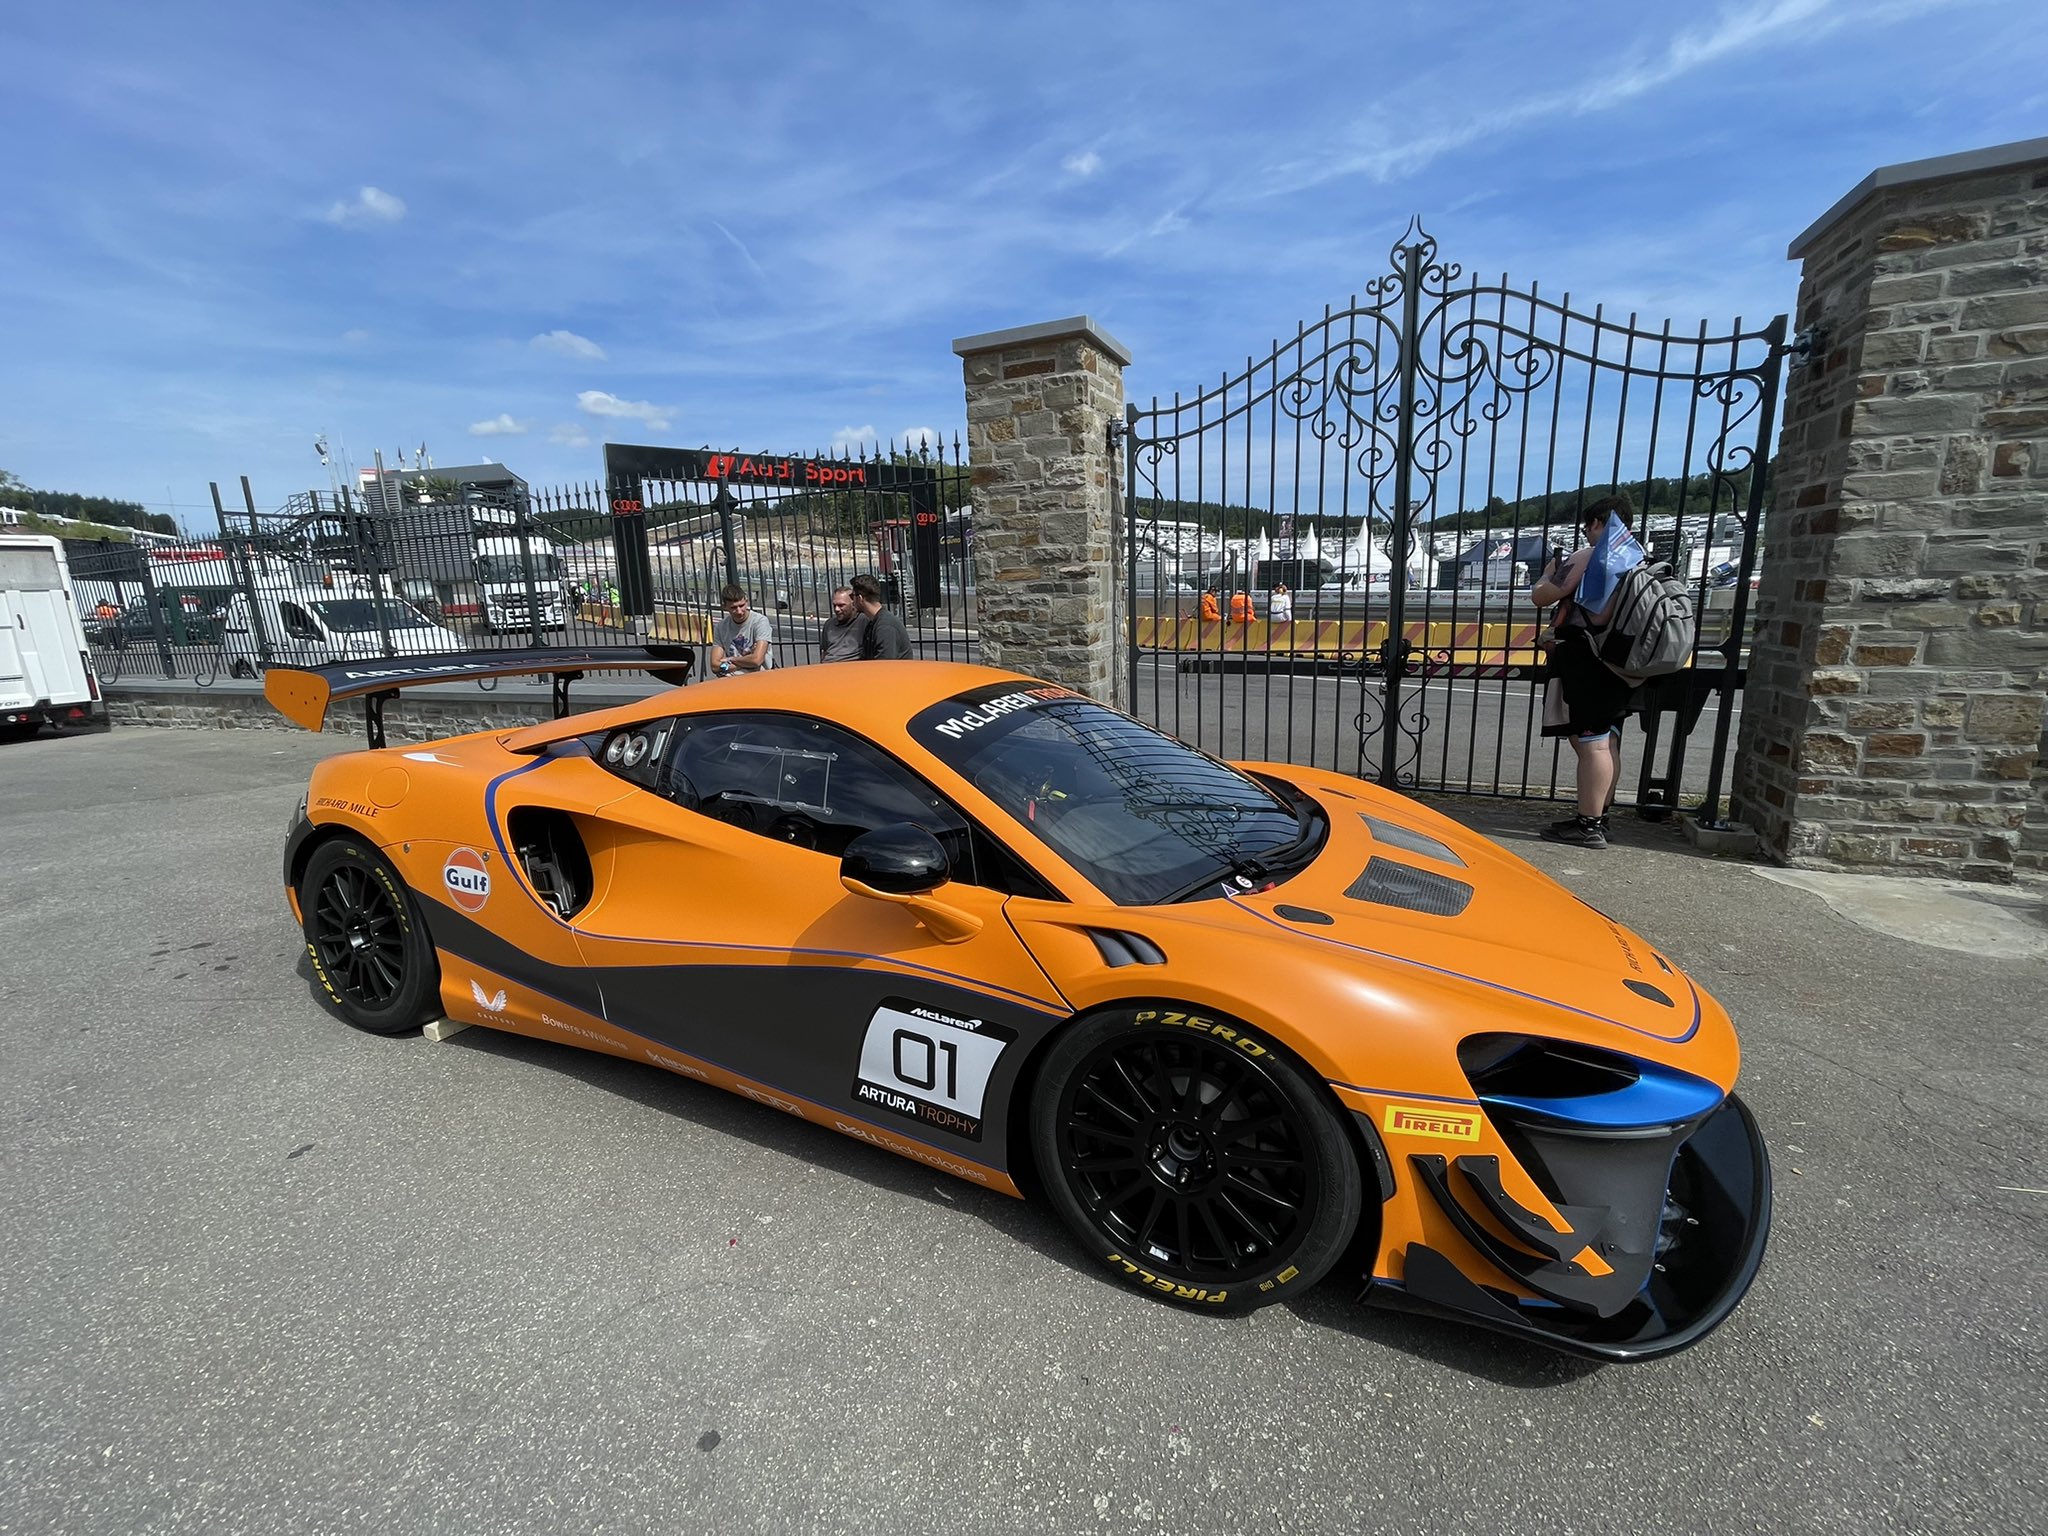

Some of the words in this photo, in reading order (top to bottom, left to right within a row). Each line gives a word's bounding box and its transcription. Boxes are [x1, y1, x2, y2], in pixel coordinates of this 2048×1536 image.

[806, 462, 866, 484] Sport
[935, 692, 1039, 739] McLAREN
[350, 803, 379, 818] MILLE
[446, 868, 487, 892] Gulf
[910, 1007, 976, 1031] McLaren
[1134, 1011, 1157, 1025] P
[1160, 1012, 1267, 1057] ZERO
[893, 1028, 957, 1100] 01
[858, 1085, 916, 1114] ARTURA
[919, 1103, 977, 1134] TROPHY
[1394, 1111, 1473, 1136] PIRELLI
[1106, 1253, 1229, 1303] PIRELLI
